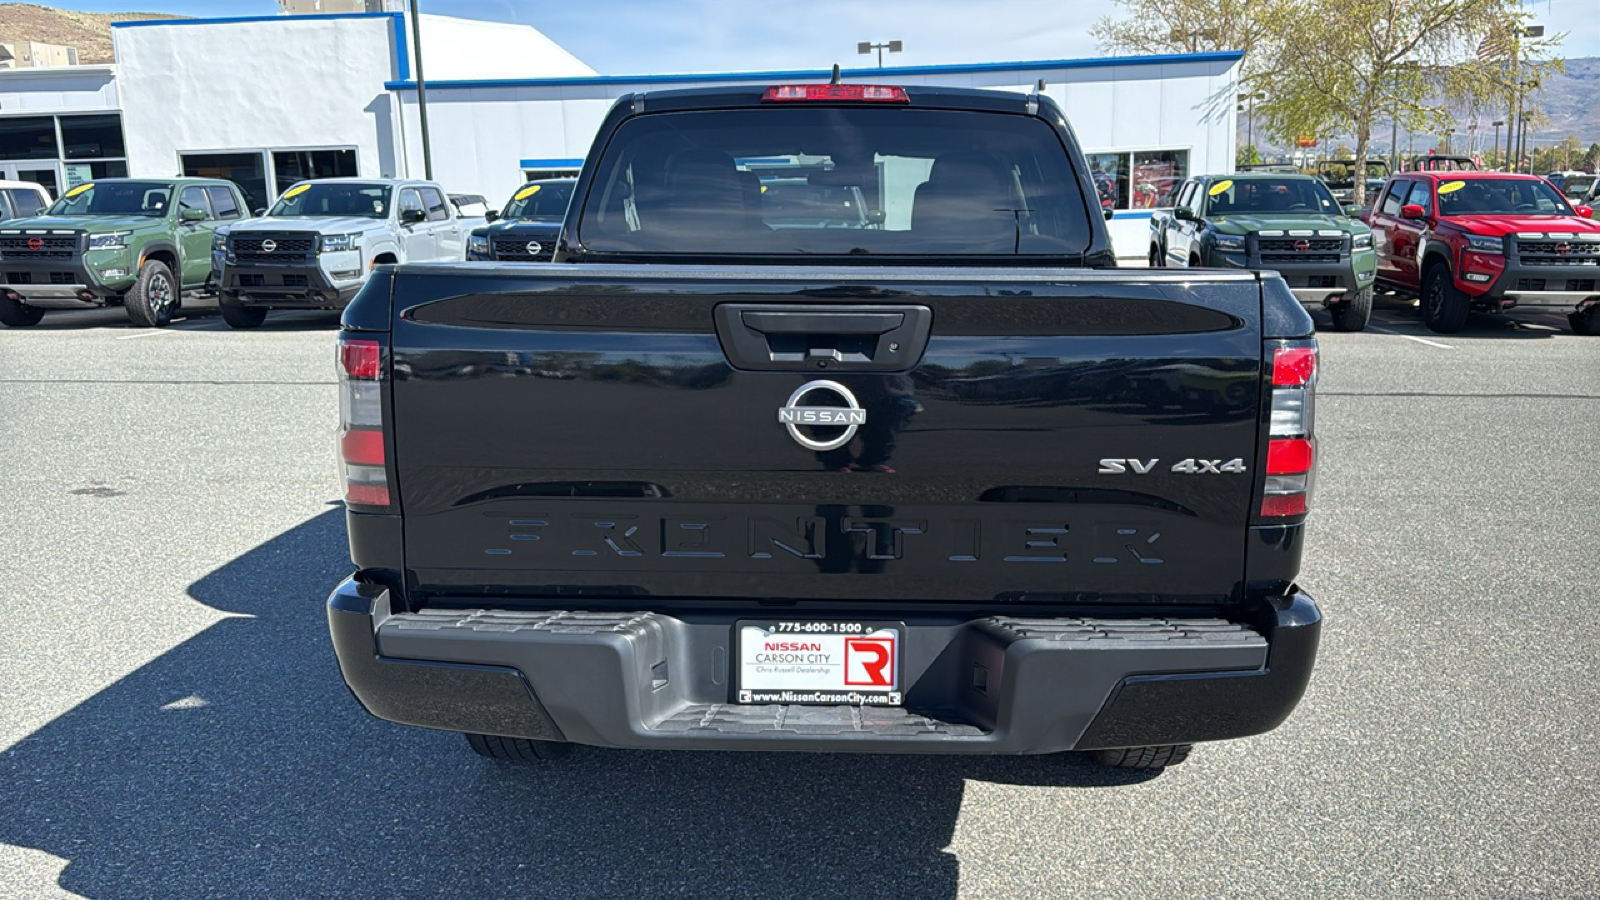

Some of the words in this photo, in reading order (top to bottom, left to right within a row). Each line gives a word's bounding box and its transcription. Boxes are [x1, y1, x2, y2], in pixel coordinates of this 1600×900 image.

[780, 410, 863, 422] NISSAN
[1098, 458, 1159, 474] SV
[484, 511, 1165, 563] FRONTIER
[778, 621, 862, 632] 775-600-1500
[764, 642, 821, 651] NISSAN
[755, 653, 804, 664] CARSON
[807, 653, 831, 664] CITY
[755, 666, 773, 674] Chris
[774, 666, 795, 674] Russell
[796, 666, 831, 675] Dealership
[753, 690, 888, 705] www.NissanCarsonCity.com
